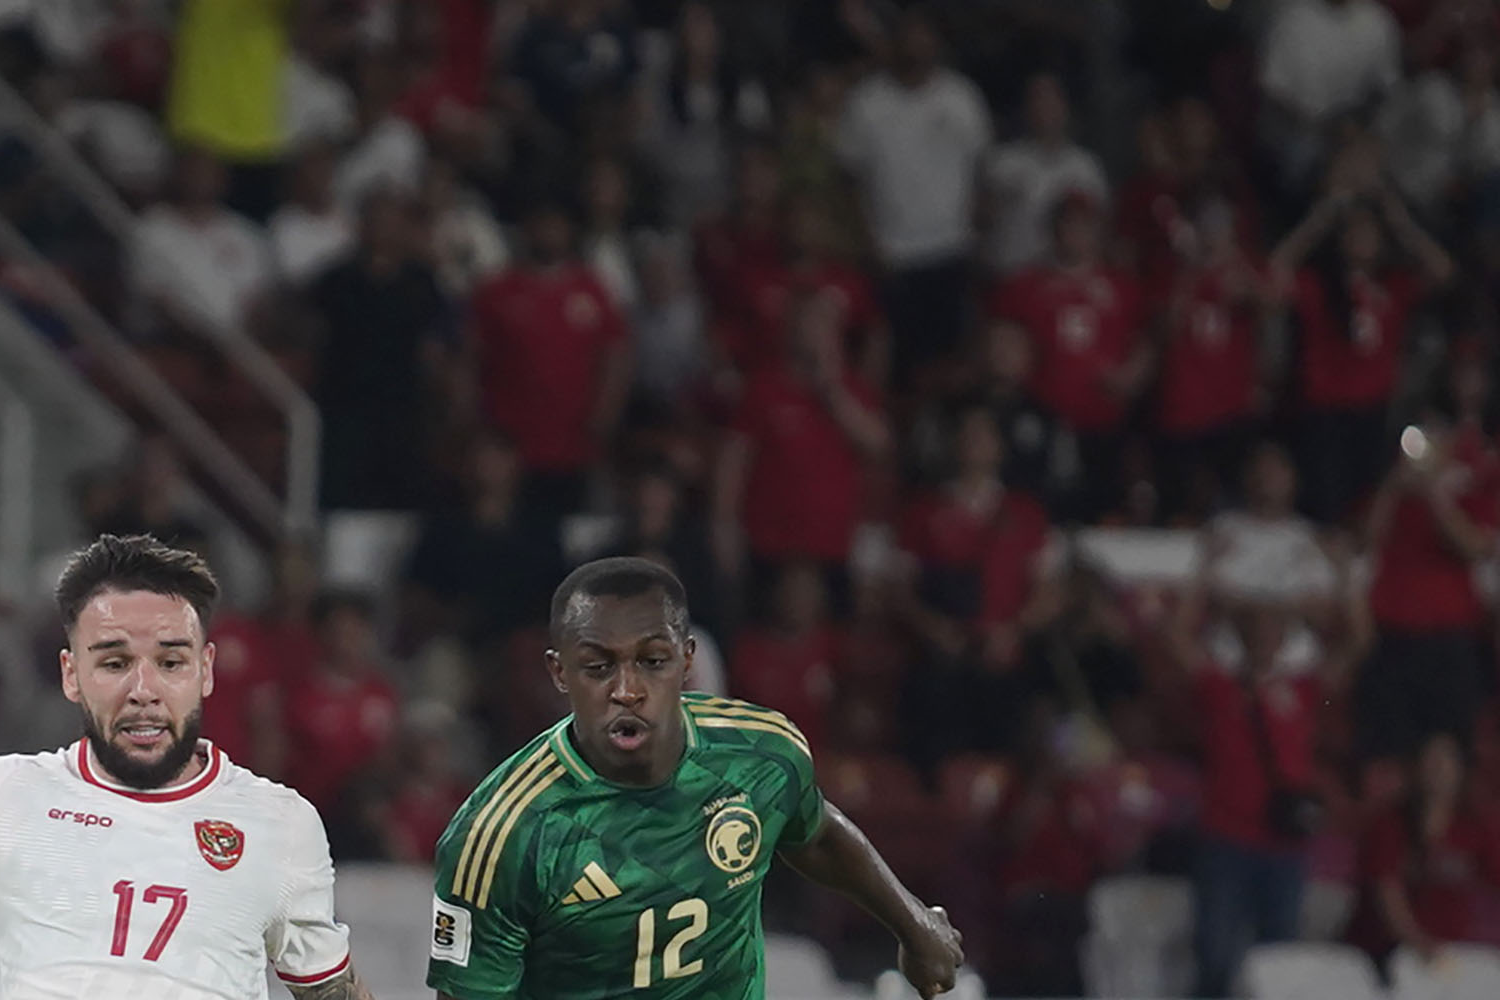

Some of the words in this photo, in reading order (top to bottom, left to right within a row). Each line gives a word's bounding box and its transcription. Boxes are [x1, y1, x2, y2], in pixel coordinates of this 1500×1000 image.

[48, 808, 113, 828] erspo
[110, 880, 188, 962] 17
[632, 897, 709, 989] 12
